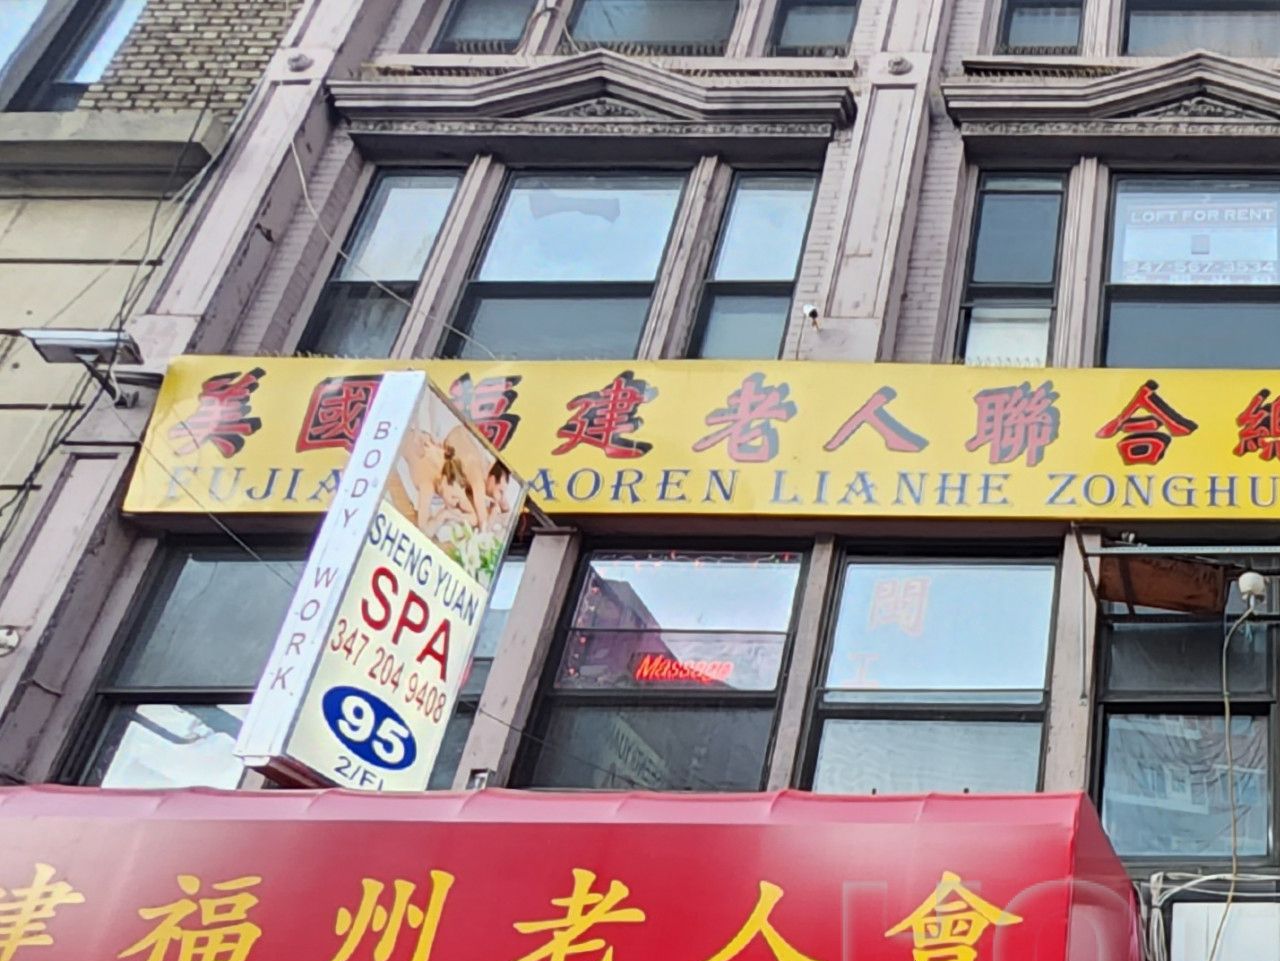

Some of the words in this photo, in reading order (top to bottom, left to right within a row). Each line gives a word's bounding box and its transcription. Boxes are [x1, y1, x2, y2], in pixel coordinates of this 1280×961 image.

[1131, 210, 1178, 223] LOFT
[1182, 208, 1219, 221] FOR
[1224, 208, 1274, 221] RENT
[165, 464, 346, 503] FUJIA
[772, 470, 1011, 506] LIANHE
[343, 420, 392, 529] BODY
[367, 512, 434, 586] SHENG
[434, 572, 479, 627] YUAN
[269, 566, 339, 691] WORK
[329, 618, 369, 667] 347
[368, 647, 402, 695] 204
[404, 671, 447, 725] 9408
[361, 566, 451, 682] SPA
[635, 653, 734, 683] Massage
[337, 694, 411, 766] 95
